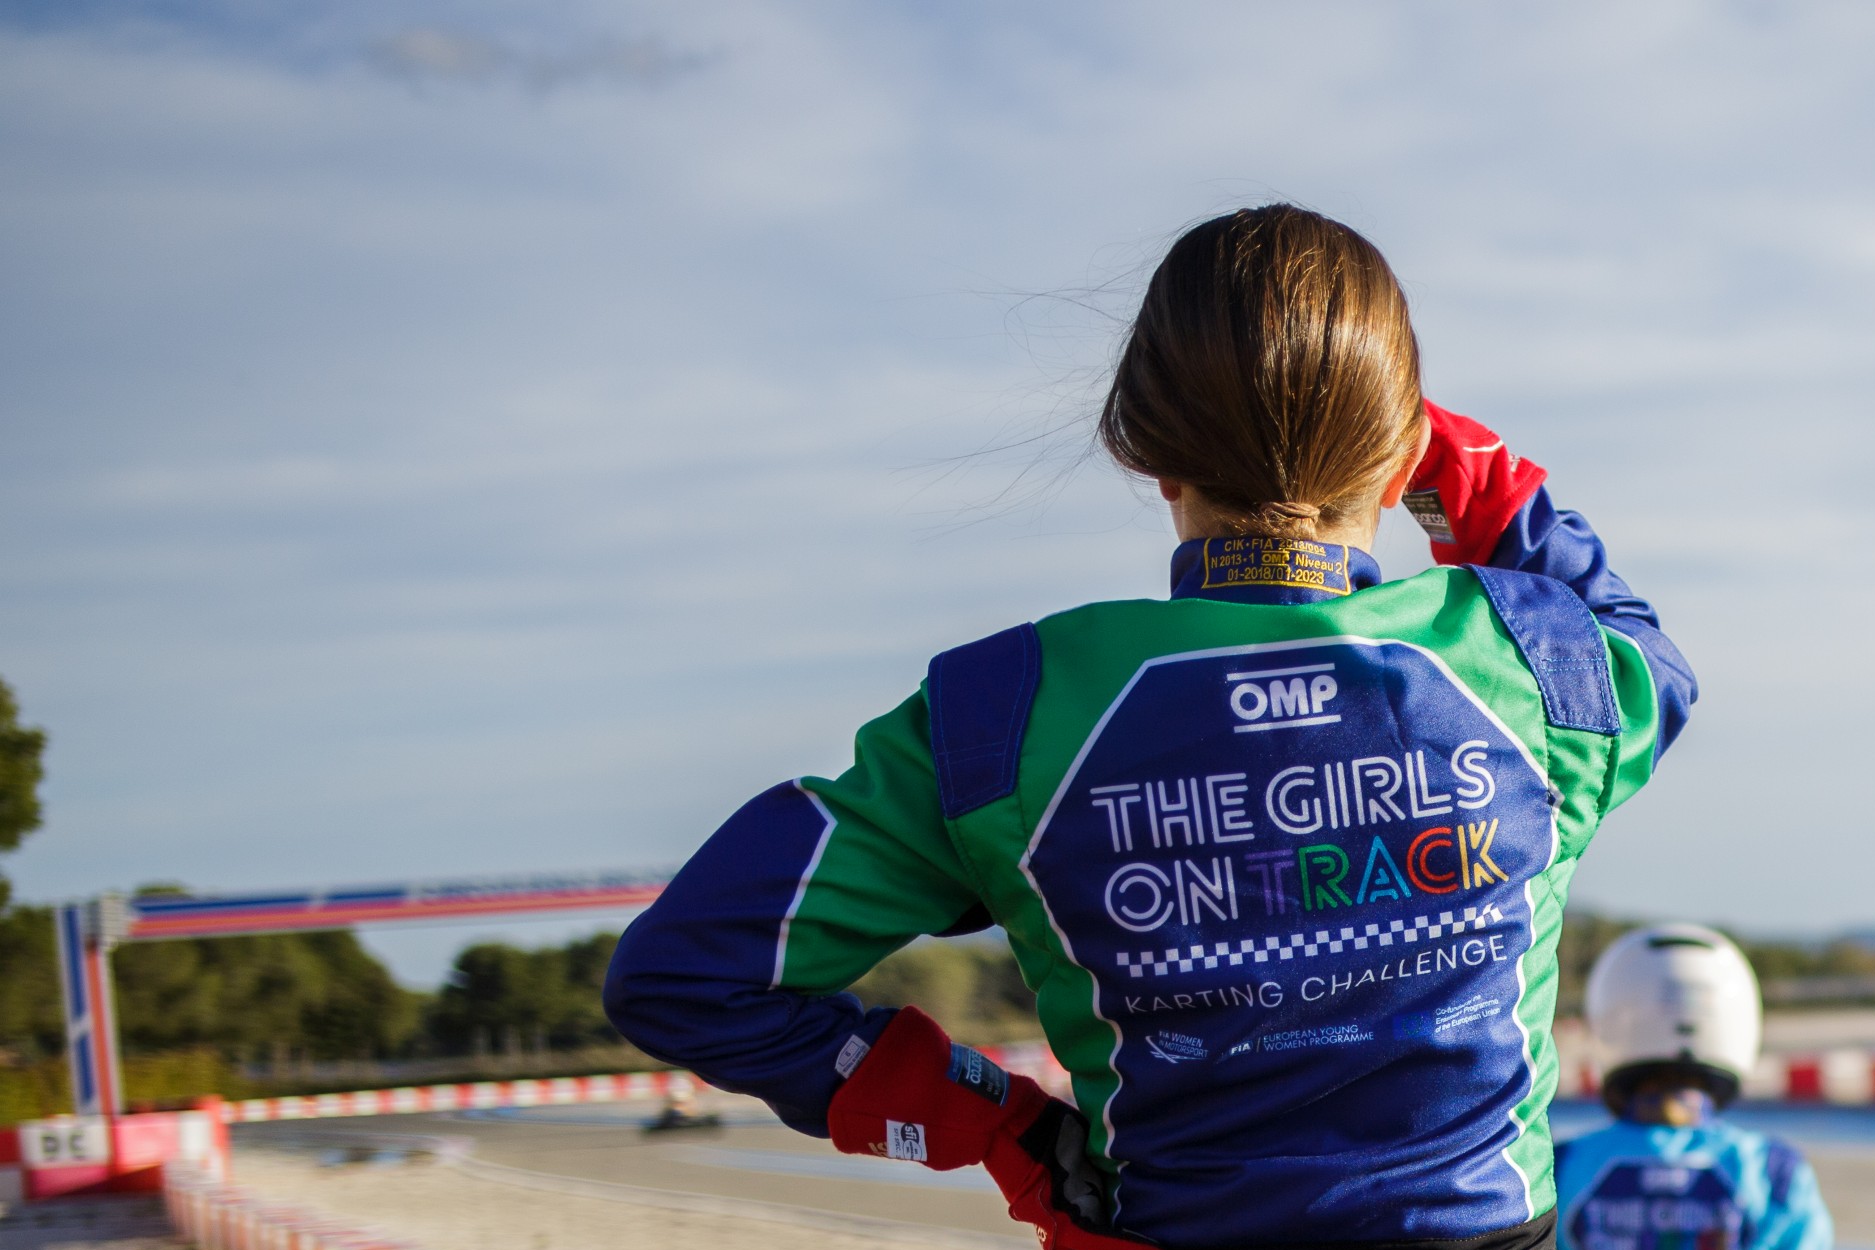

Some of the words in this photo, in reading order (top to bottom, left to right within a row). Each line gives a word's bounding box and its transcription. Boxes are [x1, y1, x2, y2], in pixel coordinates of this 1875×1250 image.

[1295, 552, 1334, 572] Niveau
[1335, 562, 1343, 576] 2
[1230, 675, 1338, 720] OMP
[1091, 772, 1254, 853] THE
[1265, 740, 1496, 835] GIRLS
[1104, 857, 1239, 933] ON
[1245, 818, 1509, 915] TRACK
[1125, 981, 1283, 1014] KARTING
[1301, 934, 1508, 1002] CHALLENGE
[1452, 1014, 1481, 1026] European
[1482, 1008, 1500, 1017] Union
[1171, 1032, 1204, 1048] WOMEN
[1263, 1029, 1317, 1044] EUROPEAN
[1320, 1024, 1359, 1036] YOUNG
[1264, 1040, 1306, 1051] WOMEN
[1310, 1031, 1374, 1045] PROGRAMME
[1164, 1041, 1208, 1058] MOTORSPORT
[1230, 1043, 1251, 1055] FIA
